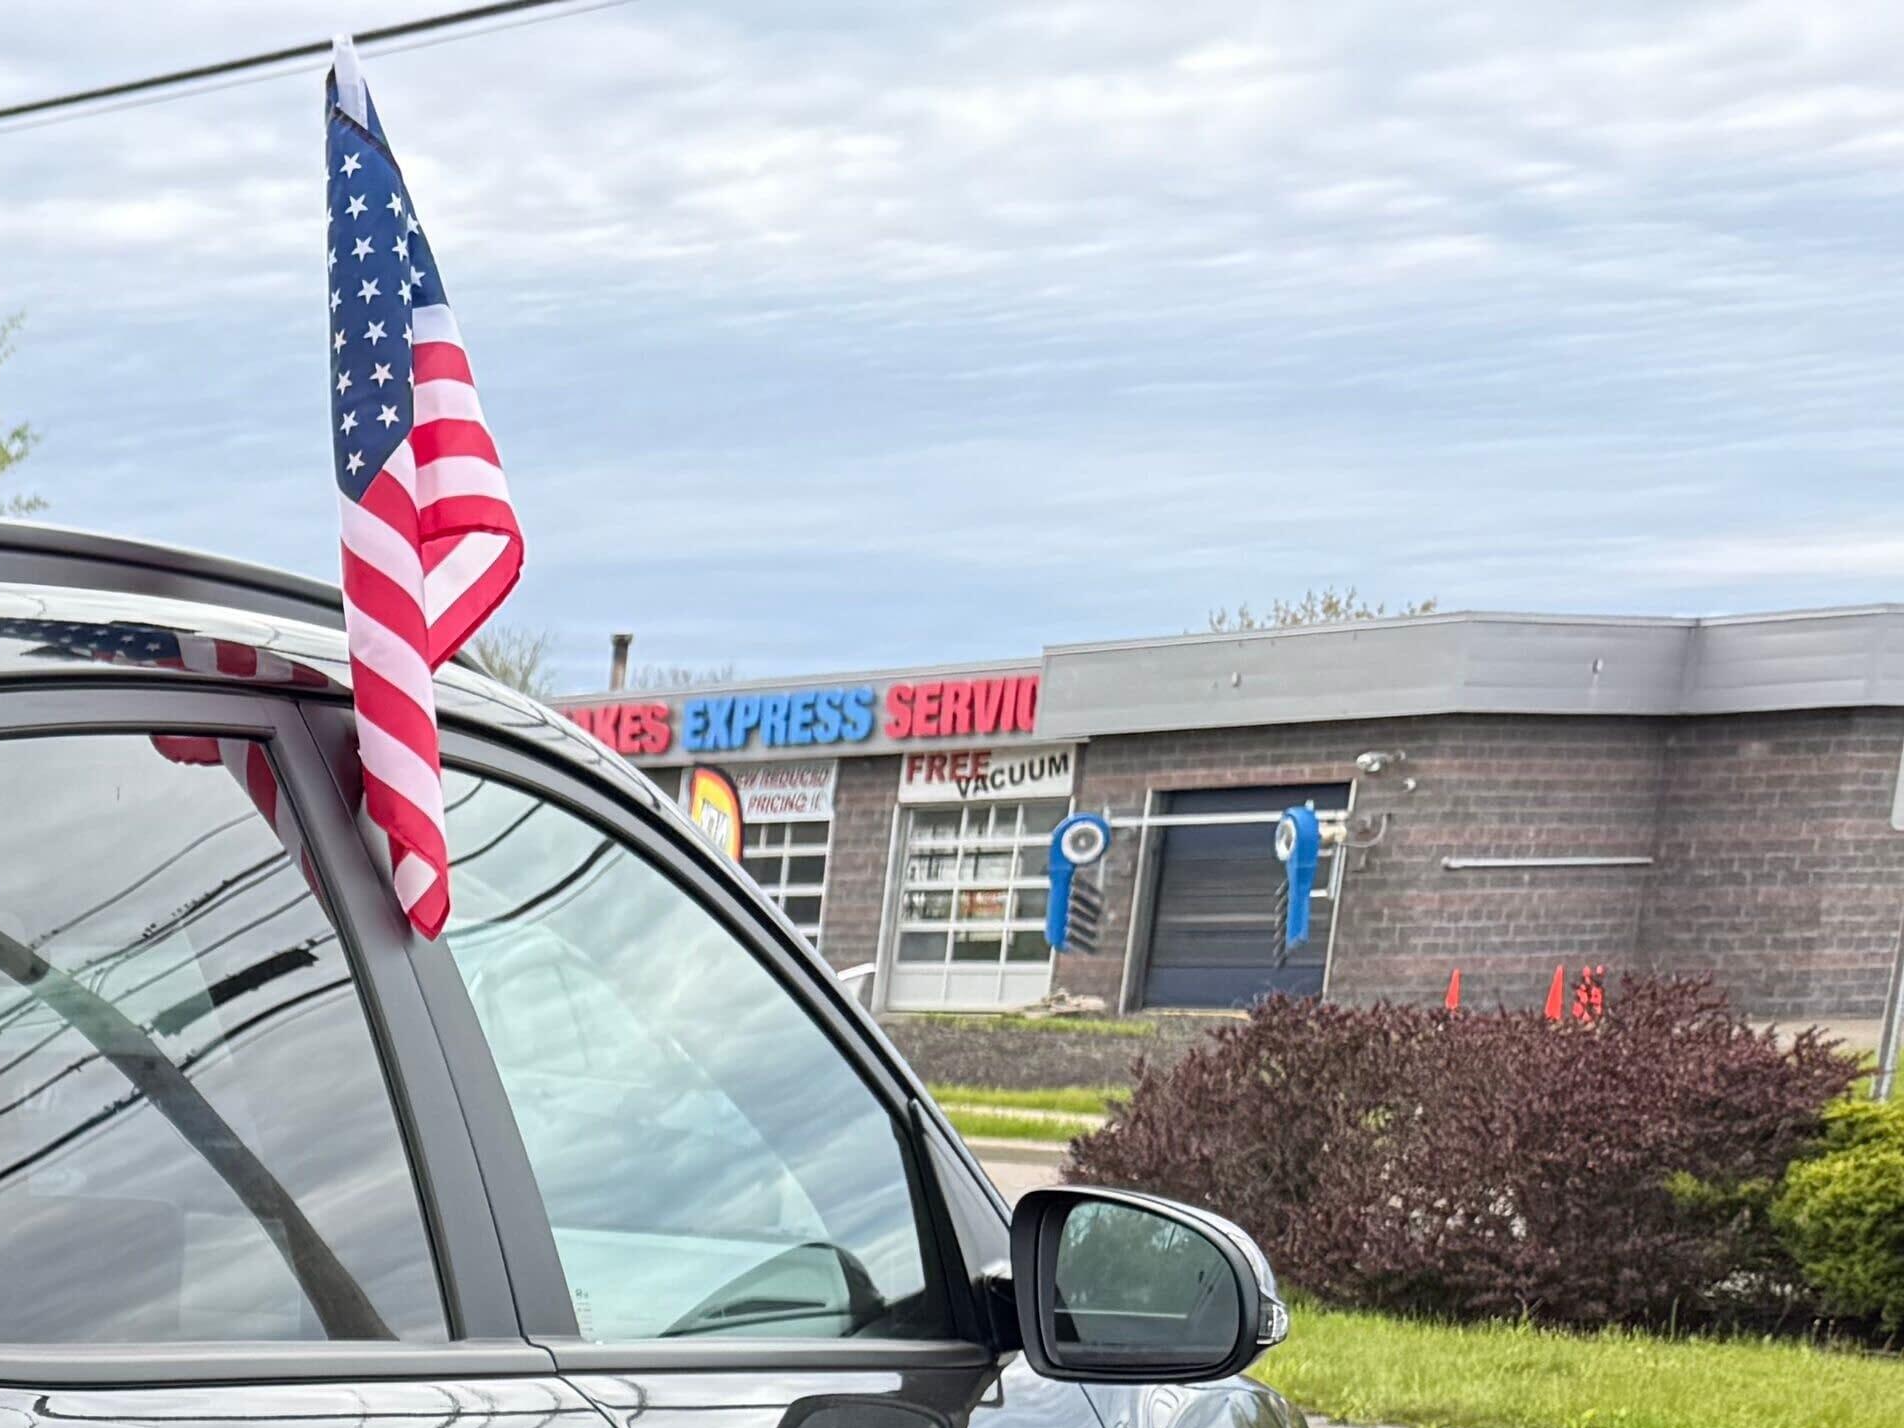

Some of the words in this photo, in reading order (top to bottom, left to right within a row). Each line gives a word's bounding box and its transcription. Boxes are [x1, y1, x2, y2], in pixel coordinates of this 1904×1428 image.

[560, 700, 673, 756] AKES
[682, 685, 876, 752] EXPRESS
[906, 751, 992, 786] FREE
[956, 752, 1070, 799] VACUUM
